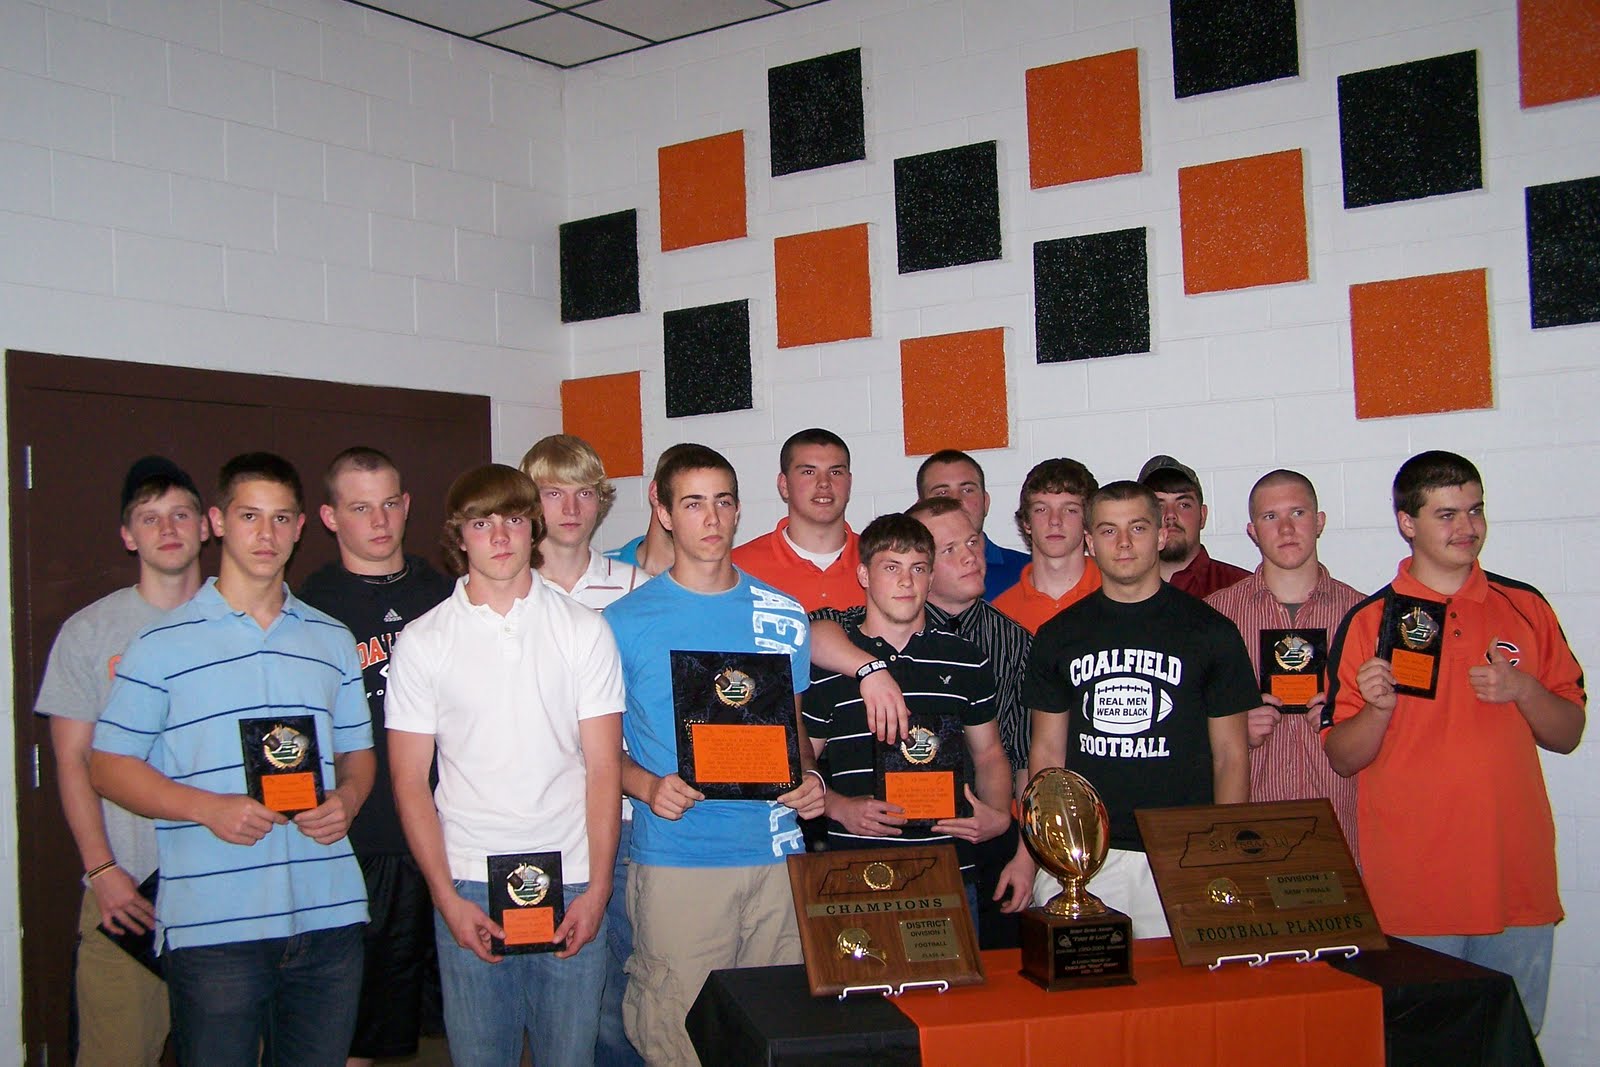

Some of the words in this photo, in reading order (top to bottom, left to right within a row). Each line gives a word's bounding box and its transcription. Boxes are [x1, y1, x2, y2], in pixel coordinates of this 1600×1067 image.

[1070, 649, 1182, 687] COALFIELD
[1099, 697, 1124, 706] REAL
[1126, 697, 1147, 706] MEN
[1096, 708, 1120, 716] WEAR
[1123, 708, 1148, 716] BLACK
[1079, 733, 1170, 758] FOOTBALL
[1277, 873, 1319, 884] DIVISION
[826, 898, 944, 915] CHAMPIONS
[906, 919, 948, 930] DISTRICT
[1197, 922, 1279, 942] FOOTBALL
[1287, 914, 1364, 934] PLAYOFFS
[910, 929, 940, 937] DIVISION
